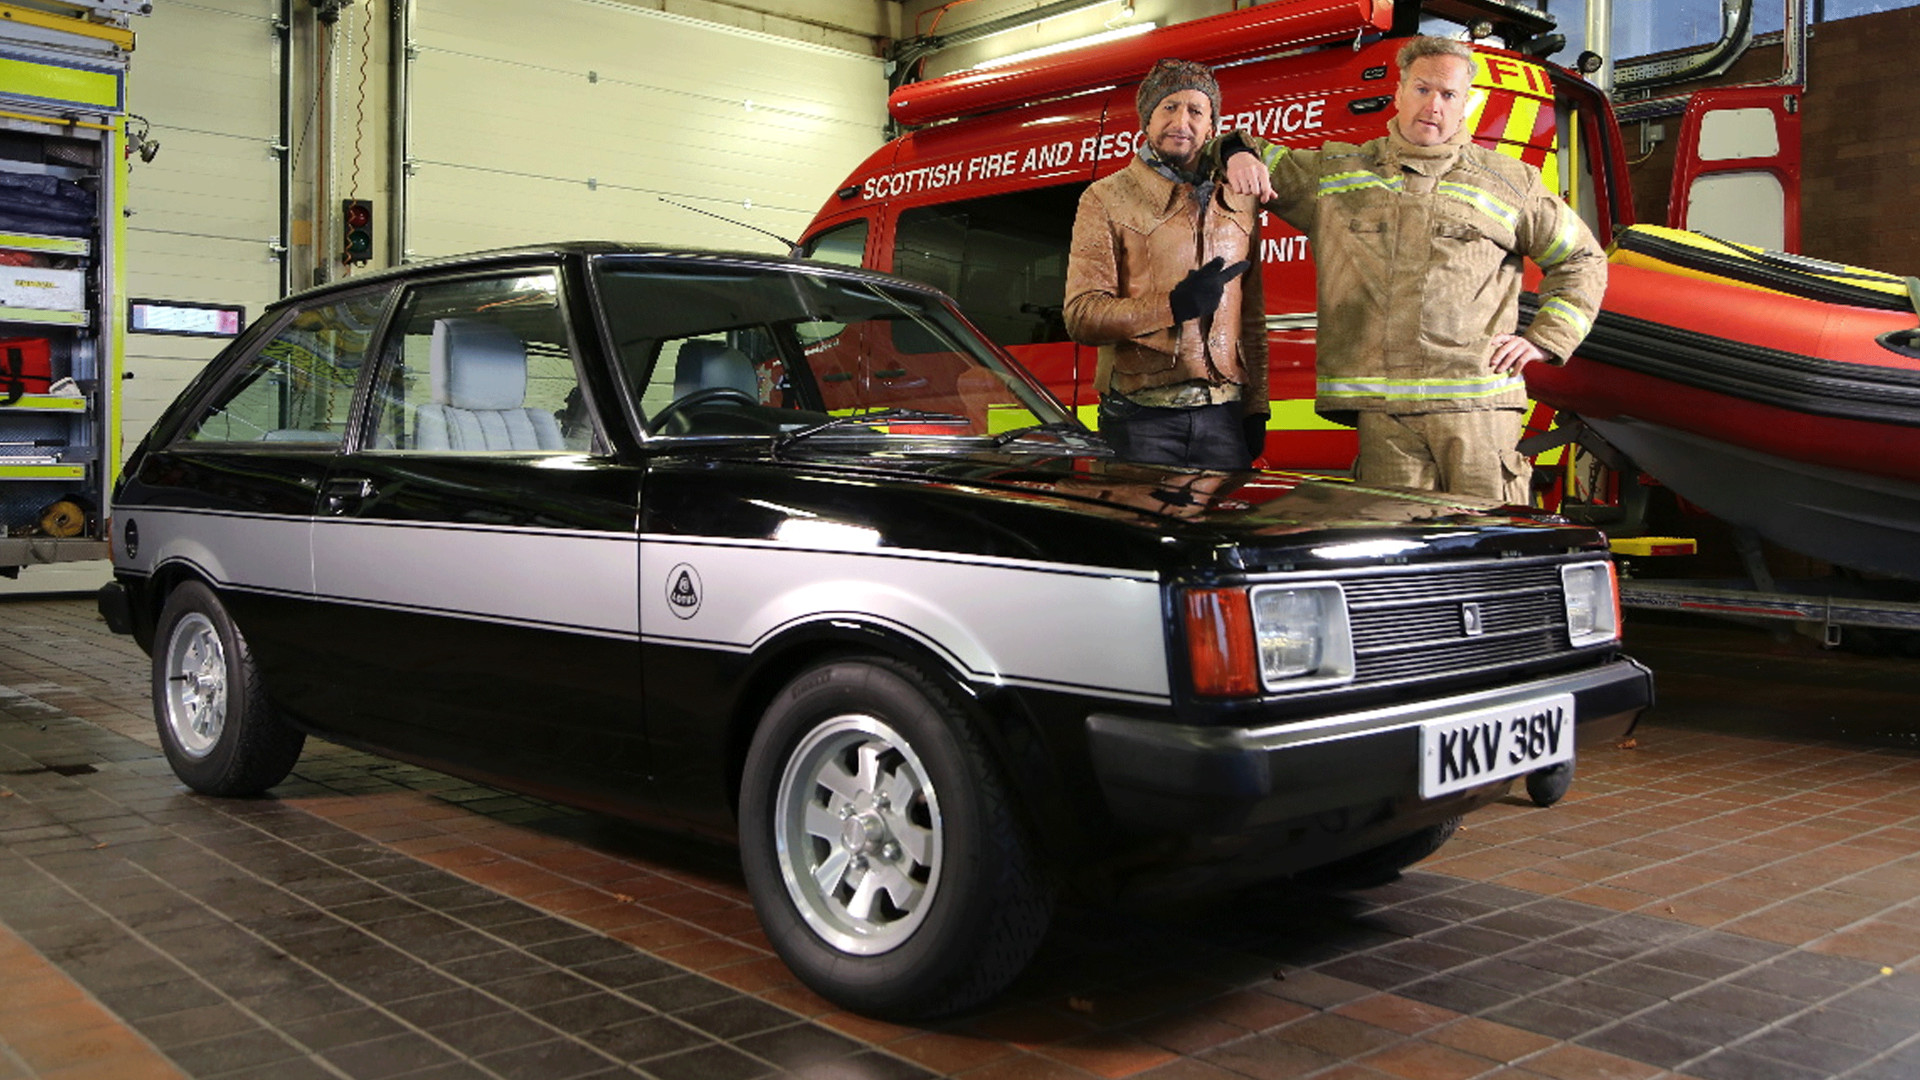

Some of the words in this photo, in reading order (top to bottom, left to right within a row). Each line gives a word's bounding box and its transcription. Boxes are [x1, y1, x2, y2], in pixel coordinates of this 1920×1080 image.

[863, 161, 963, 200] SCOTTISH
[967, 150, 1019, 180] FIRE
[1021, 141, 1073, 172] AND
[1078, 130, 1144, 163] RESC
[1215, 99, 1326, 136] ERVICE
[1439, 720, 1502, 784] KKV
[1509, 706, 1563, 764] 38V
